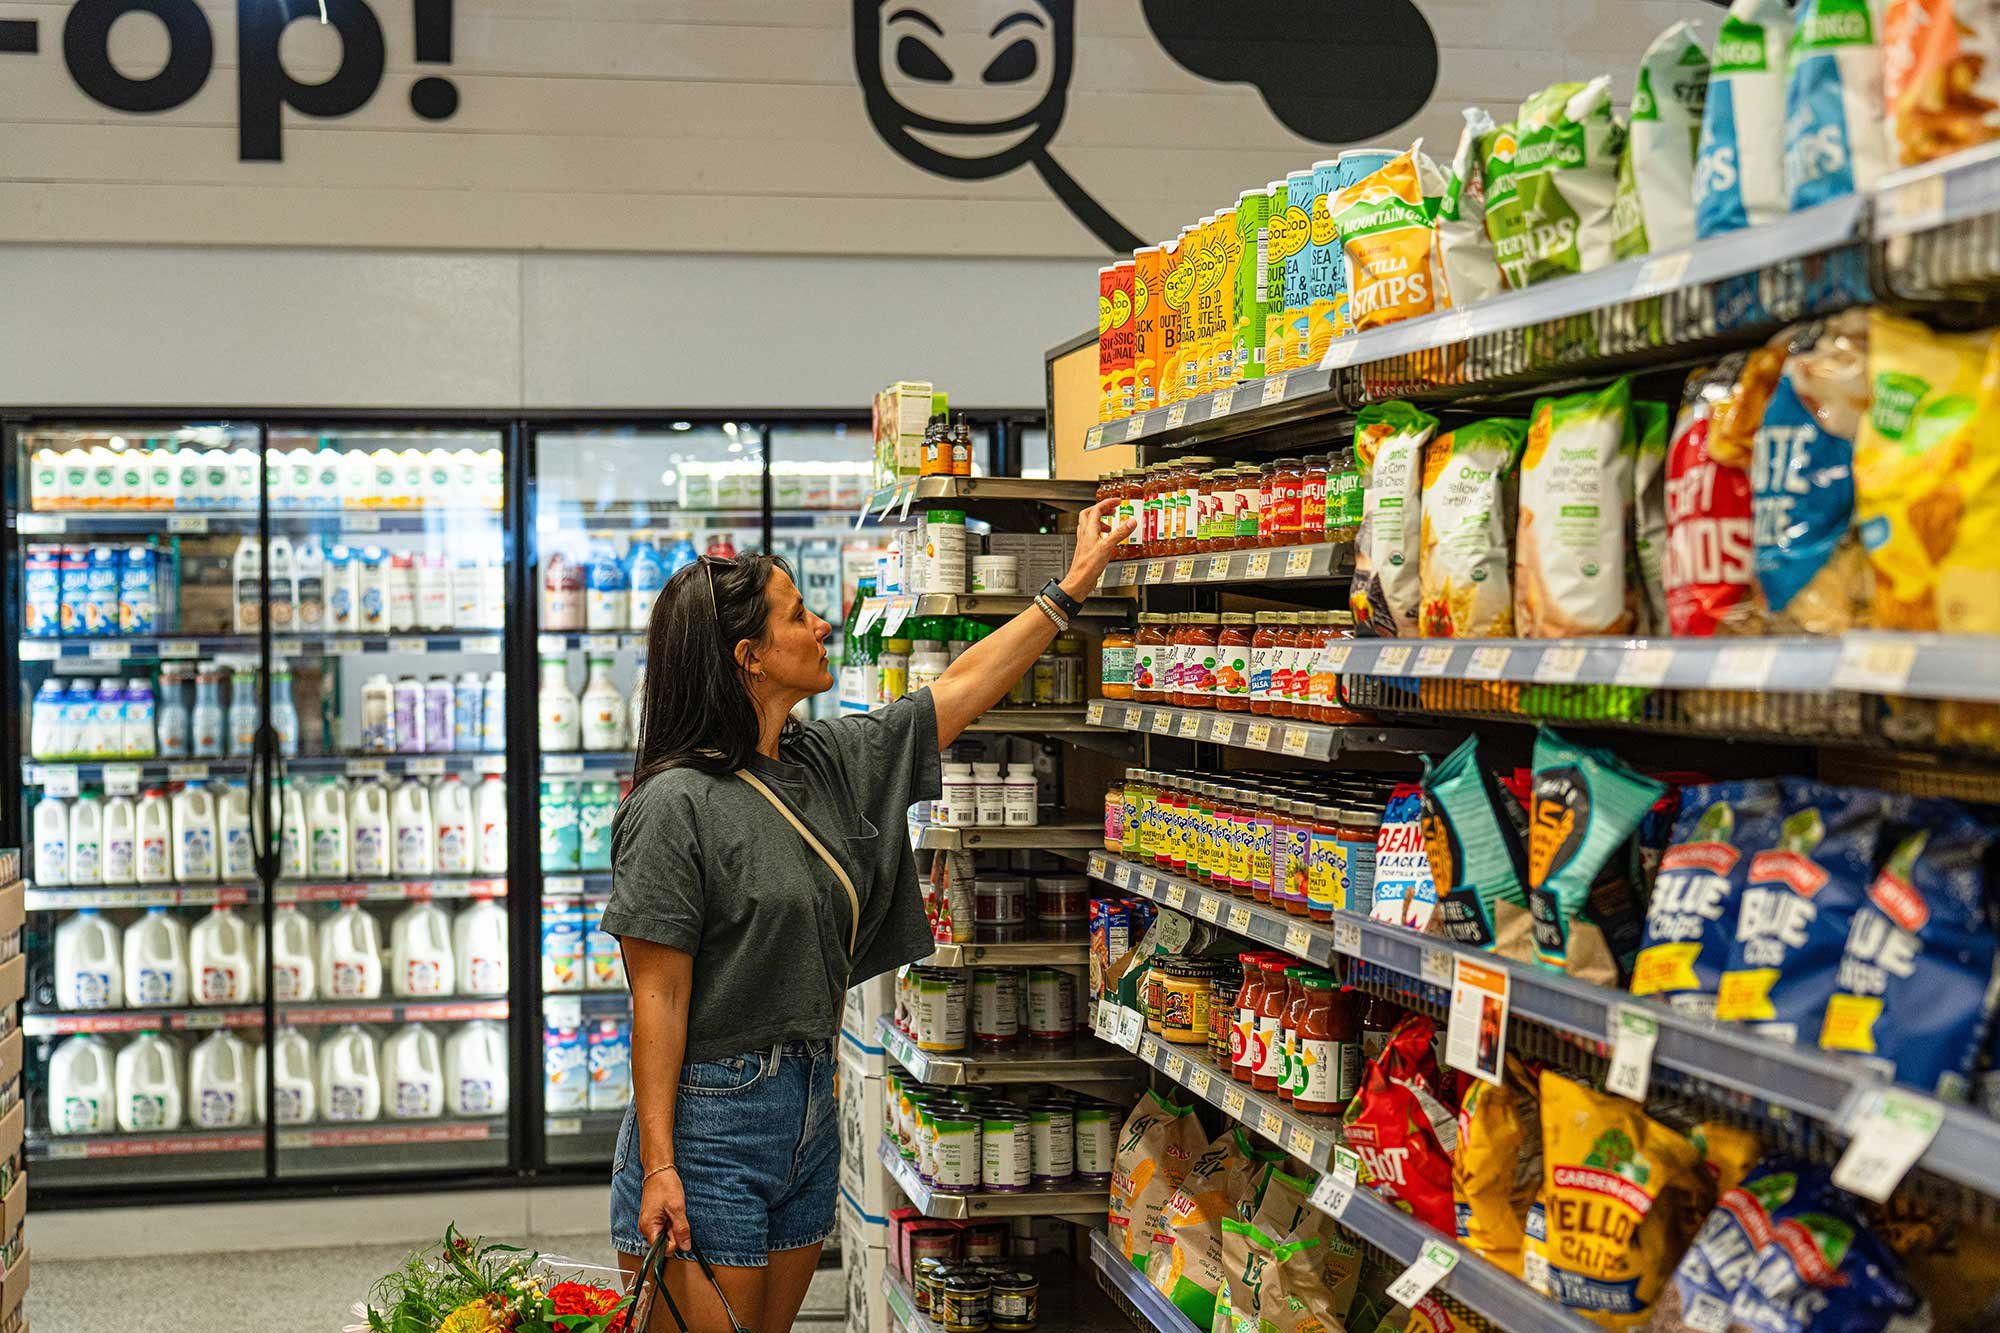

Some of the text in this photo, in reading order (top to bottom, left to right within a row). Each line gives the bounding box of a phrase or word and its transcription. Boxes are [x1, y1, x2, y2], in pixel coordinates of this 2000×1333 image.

[1343, 208, 1404, 234] MOUNTAIN
[1312, 249, 1331, 265] SEA
[1380, 884, 1403, 899] Salt
[1650, 874, 1731, 921] BLUE
[1173, 1194, 1196, 1218] SALT
[1559, 1234, 1629, 1277] Chips
